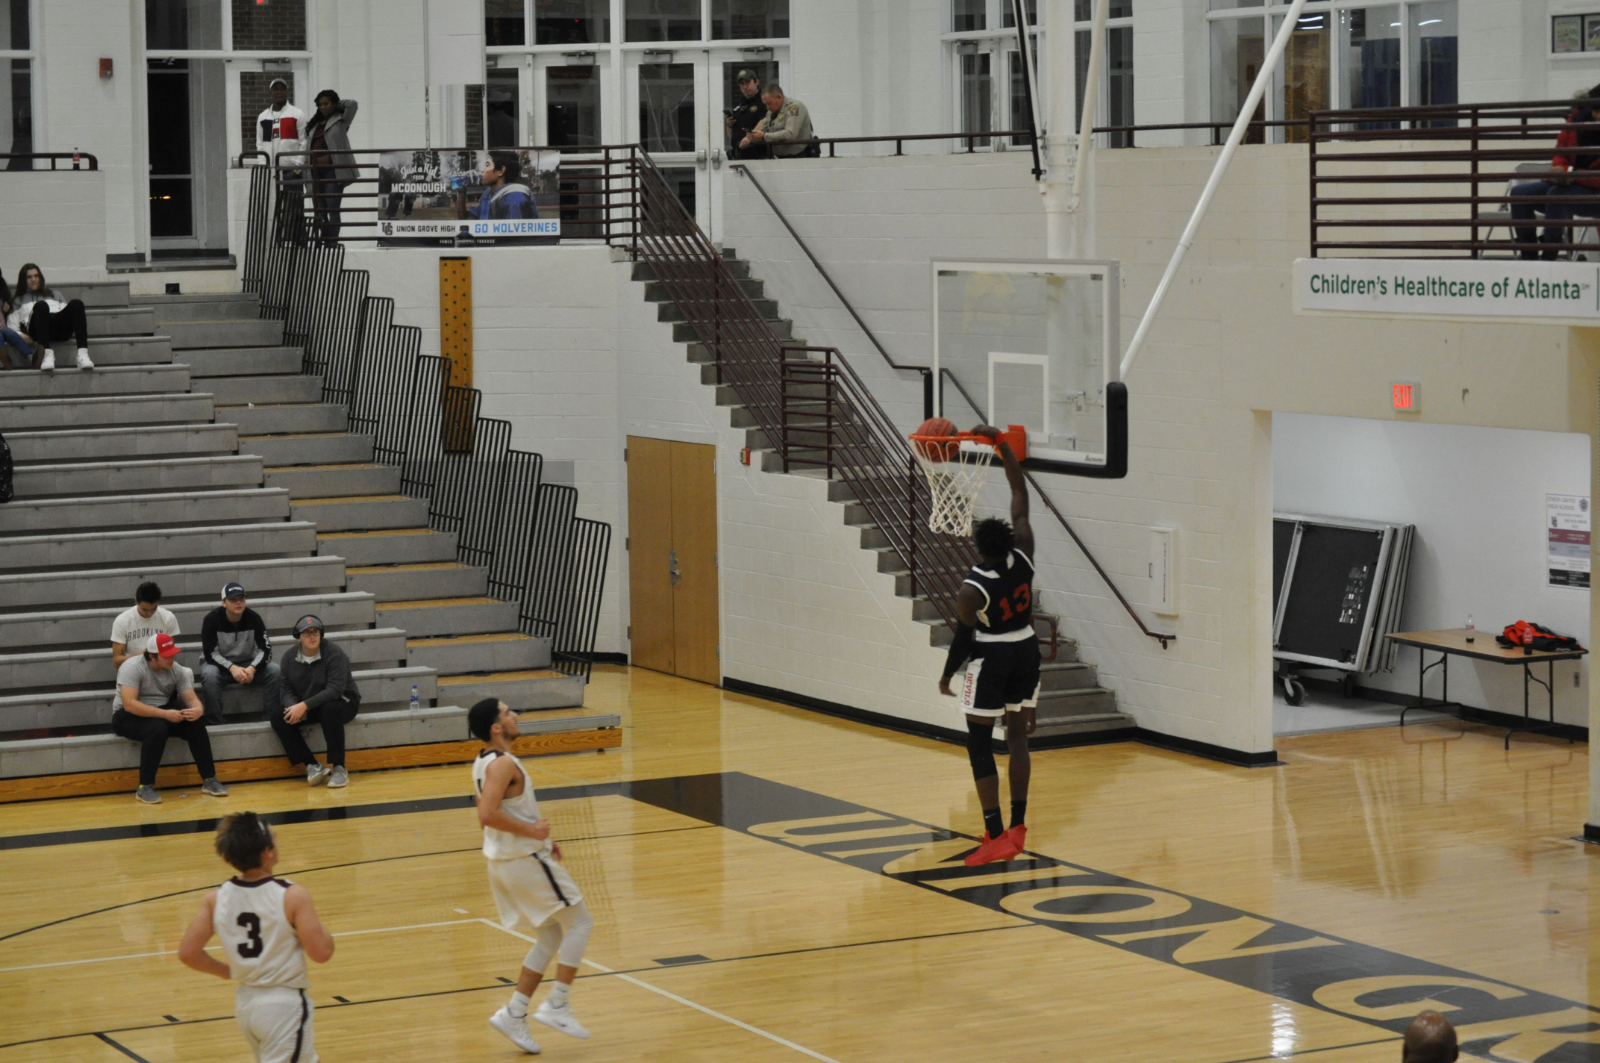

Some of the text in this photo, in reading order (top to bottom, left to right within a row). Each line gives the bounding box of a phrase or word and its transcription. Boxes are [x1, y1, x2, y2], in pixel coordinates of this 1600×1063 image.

[391, 182, 447, 193] MCDONOUGH
[396, 225, 456, 233] UNION GROVE HIGH
[474, 222, 558, 234] GO WOLVERINES
[1310, 273, 1580, 300] Children's Healthcare of Atlanta
[1393, 384, 1413, 409] EXIT
[999, 583, 1032, 622] 13
[237, 912, 264, 959] 3
